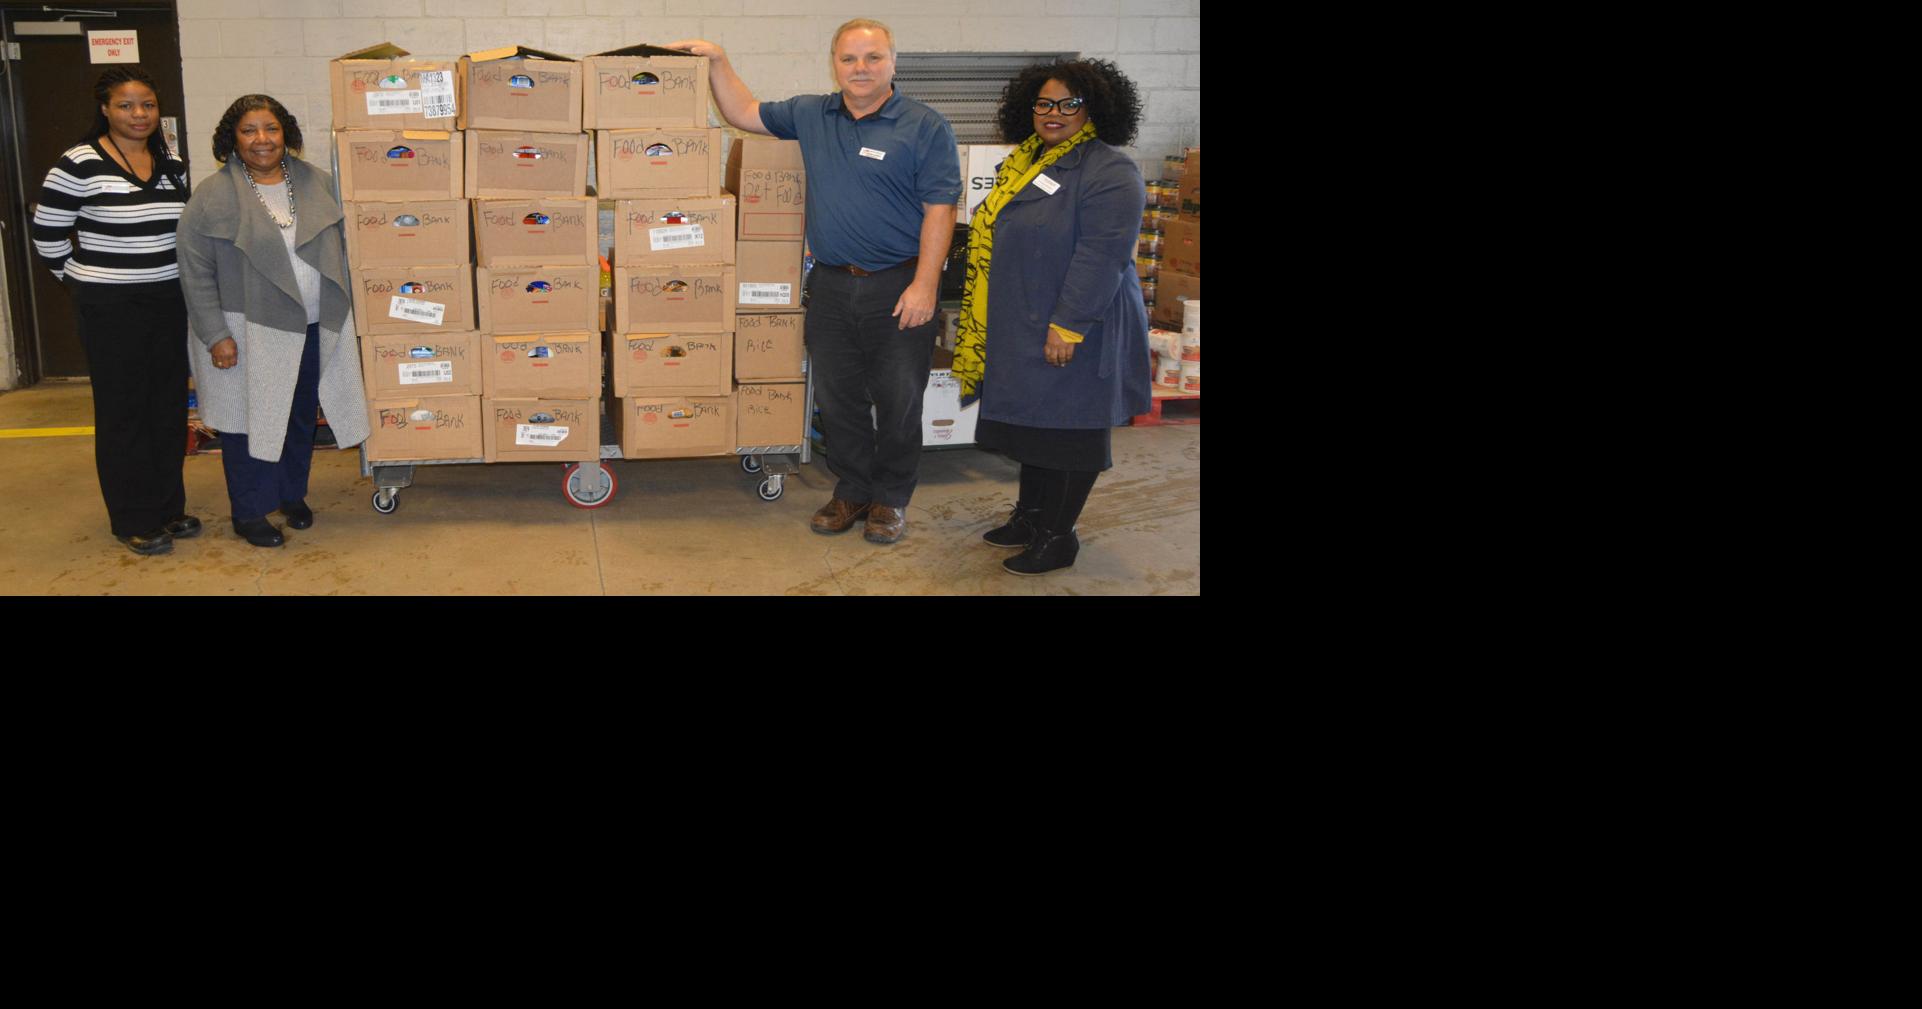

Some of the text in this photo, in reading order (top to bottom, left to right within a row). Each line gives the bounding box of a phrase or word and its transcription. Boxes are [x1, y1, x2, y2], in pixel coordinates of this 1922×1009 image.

[599, 65, 631, 94] Food
[357, 213, 387, 230] Food
[484, 210, 515, 227] Food
[627, 211, 654, 235] Food
[363, 279, 393, 296] Food
[374, 344, 405, 361] Food
